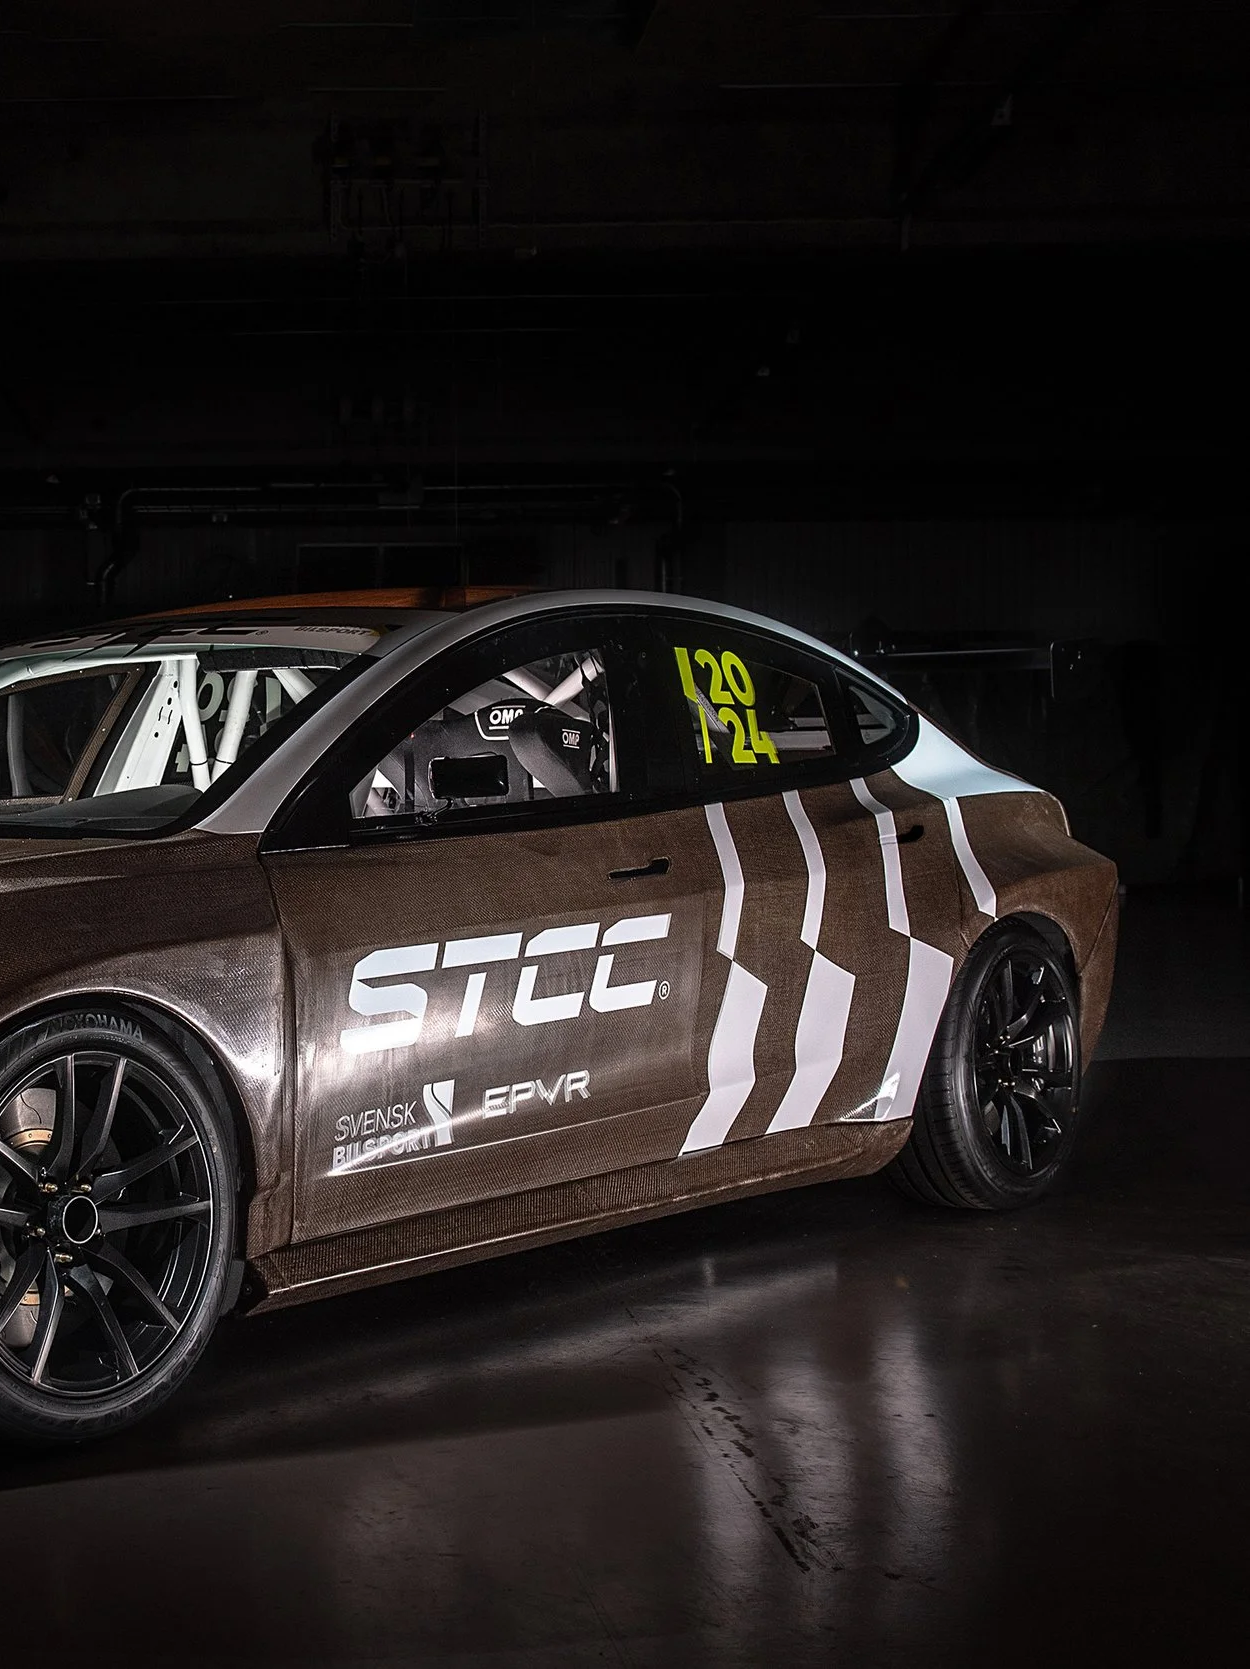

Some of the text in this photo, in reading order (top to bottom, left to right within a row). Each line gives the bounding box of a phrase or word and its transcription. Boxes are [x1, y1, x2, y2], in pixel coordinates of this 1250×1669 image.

[562, 732, 580, 745] OMP
[334, 1100, 417, 1142] SVENSK
[332, 1127, 432, 1169] BILSPORT
